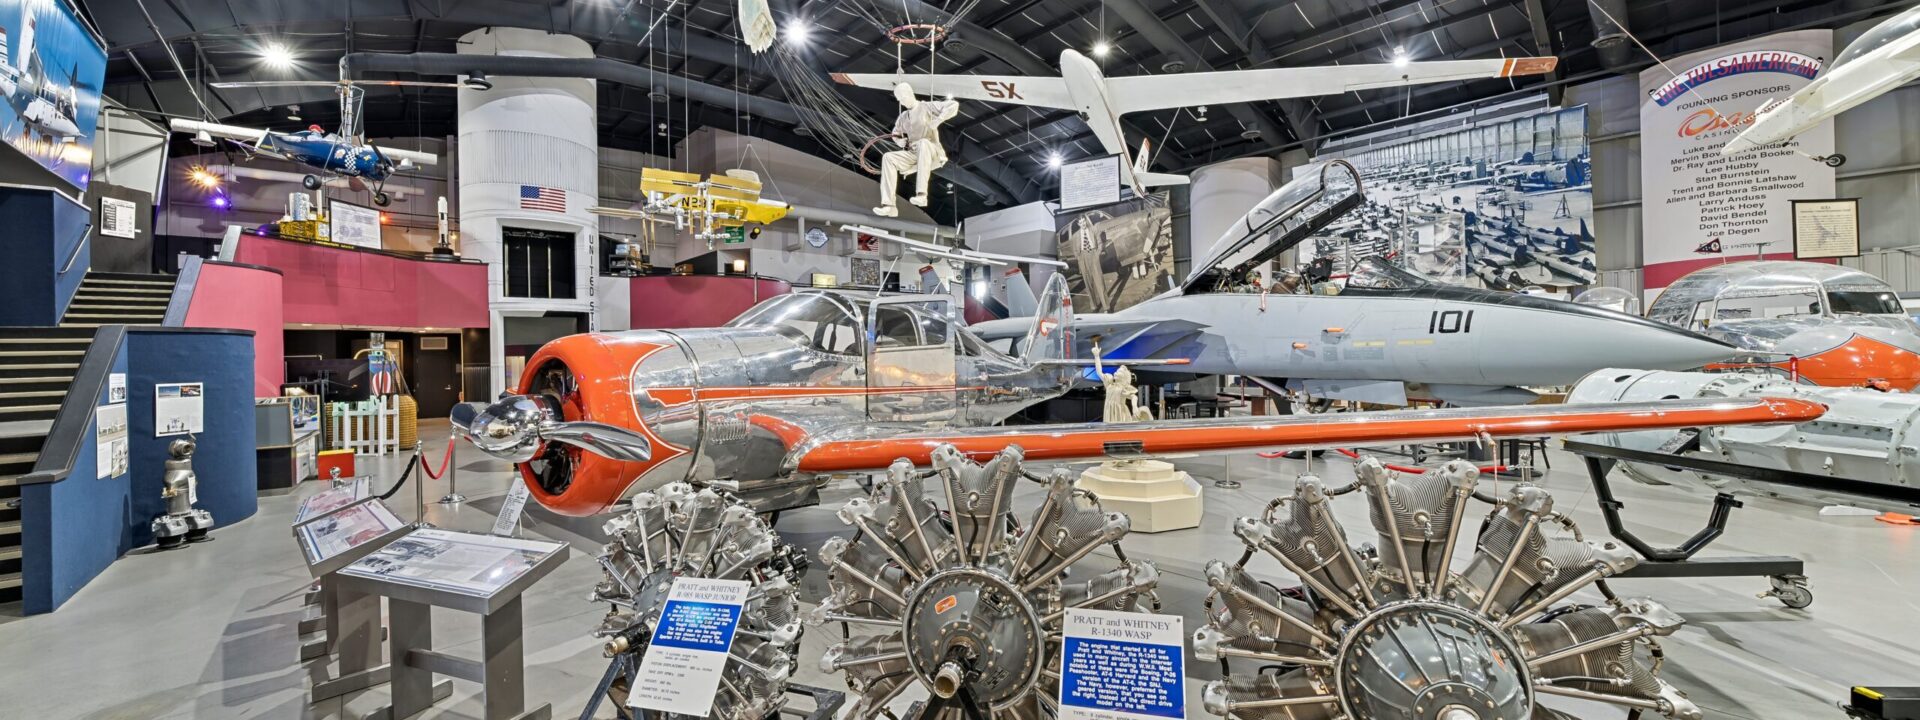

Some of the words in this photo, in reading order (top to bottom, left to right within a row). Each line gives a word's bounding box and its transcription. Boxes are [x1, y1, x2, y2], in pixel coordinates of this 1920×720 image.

[1656, 80, 1686, 102] THE
[1686, 52, 1818, 86] TULSAMERICAN
[1676, 94, 1728, 111] FOUNDING
[1731, 84, 1791, 100] SPONSORS
[1683, 146, 1704, 155] Luke
[1708, 142, 1726, 150] and
[1671, 155, 1699, 166] Mervin
[1687, 161, 1704, 170] Ray
[1707, 158, 1725, 166] and
[1729, 152, 1757, 162] Linda
[1760, 150, 1794, 158] Booker
[1705, 166, 1722, 174] Lee
[1726, 162, 1758, 171] Hubby
[1696, 175, 1717, 183] Stan
[1720, 168, 1770, 180] Burnstein
[1672, 187, 1694, 195] Trent
[1697, 183, 1714, 191] and
[1717, 179, 1753, 189] Bonnie
[1689, 192, 1705, 200] and
[1708, 188, 1748, 198] Barbara
[1751, 182, 1804, 192] Smallwood
[1699, 199, 1724, 207] Larry
[1702, 205, 1735, 214] Patrick
[1739, 202, 1764, 210] Hoey
[1700, 214, 1728, 222] David
[1732, 210, 1767, 219] Bendel
[1721, 218, 1768, 228] Thornton
[1728, 227, 1760, 236] Degen
[1429, 310, 1474, 334] 101
[1074, 616, 1104, 625] PRATT
[1124, 619, 1171, 630] WHITNEY
[1092, 628, 1122, 637] R-1340
[1125, 630, 1152, 640] WASP
